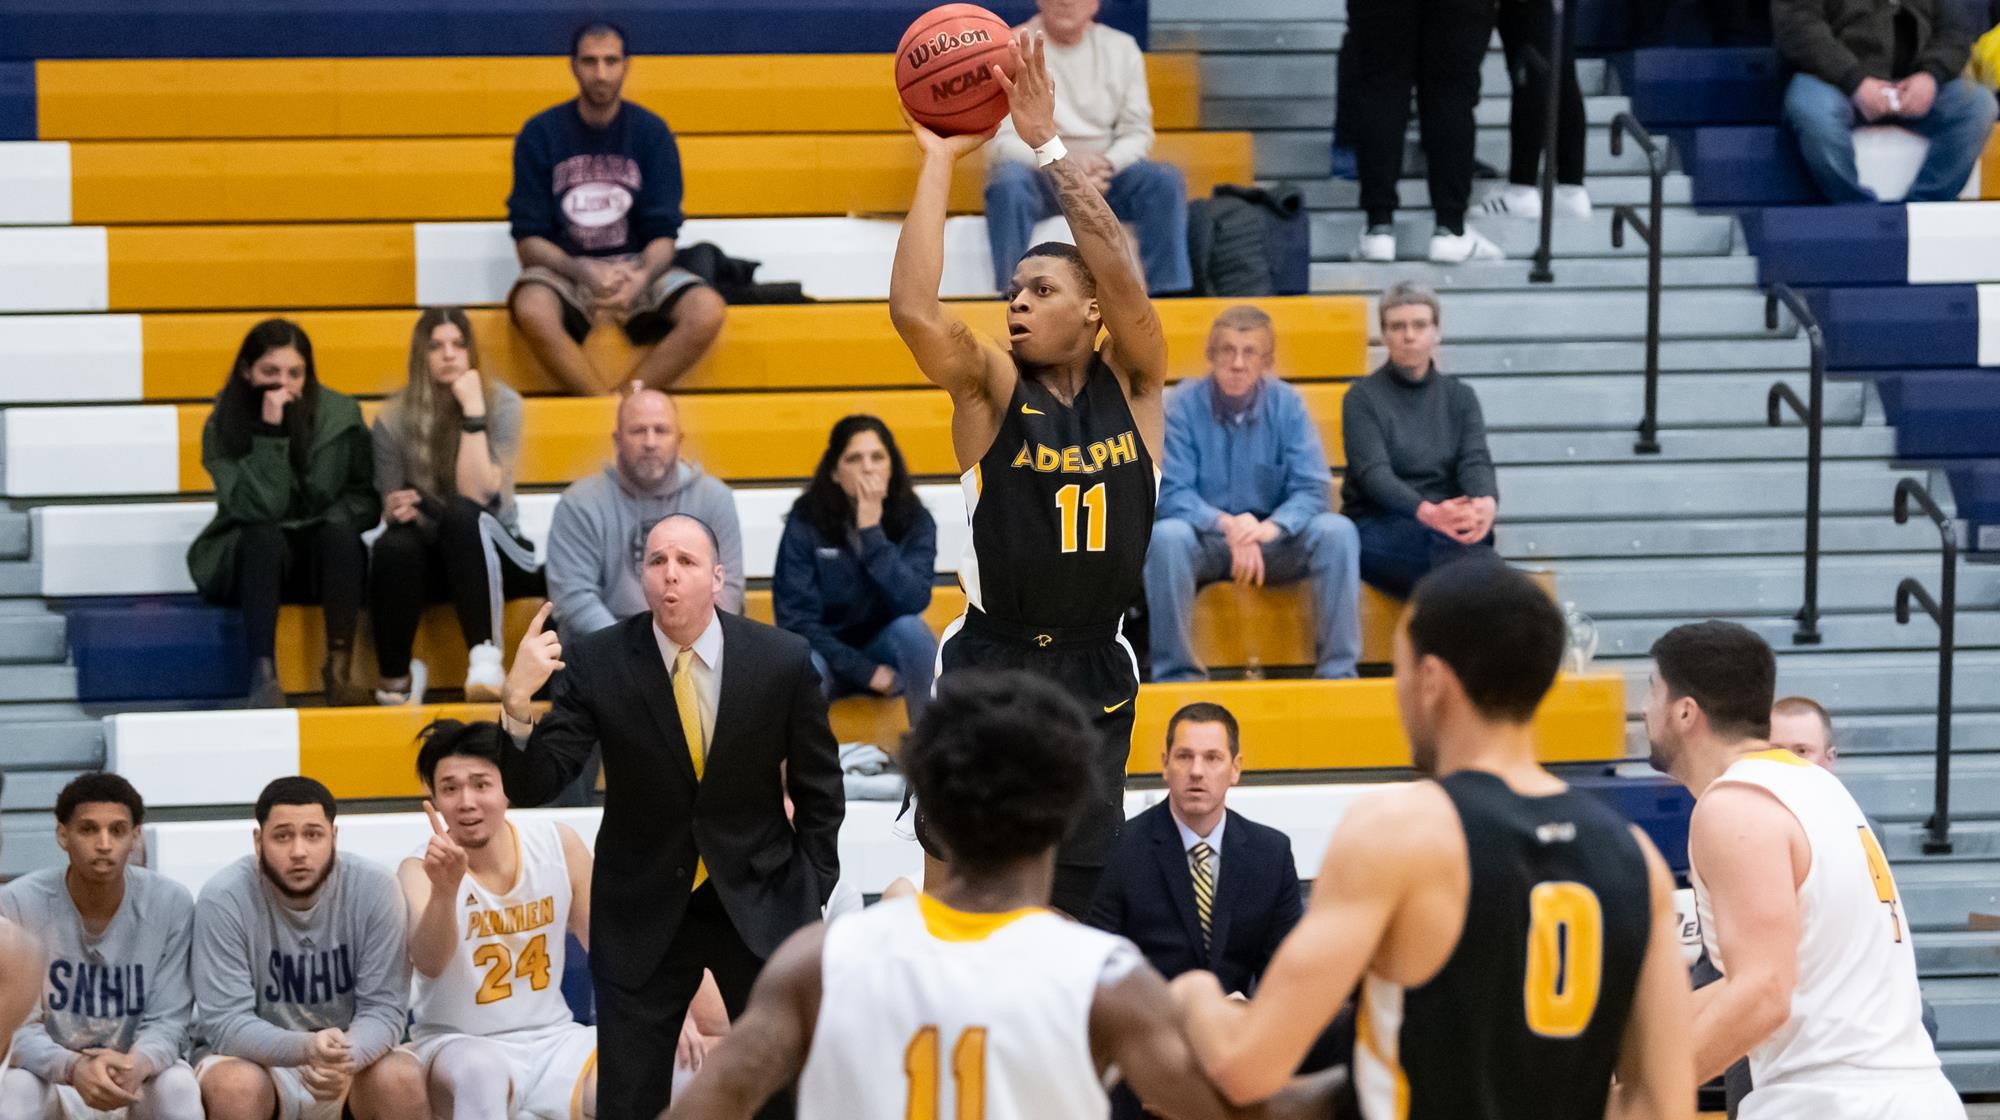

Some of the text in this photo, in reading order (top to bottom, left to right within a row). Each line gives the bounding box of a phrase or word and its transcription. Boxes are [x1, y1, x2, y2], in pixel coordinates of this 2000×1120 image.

[907, 29, 992, 70] Wilson
[931, 62, 992, 102] NCAA
[1011, 430, 1138, 473] ADELPHI
[1055, 482, 1107, 553] 11
[48, 959, 145, 1017] SNHU
[264, 944, 354, 1004] SNHU
[473, 933, 551, 1005] 24
[1523, 880, 1604, 1039] 0
[902, 1023, 988, 1120] 11
